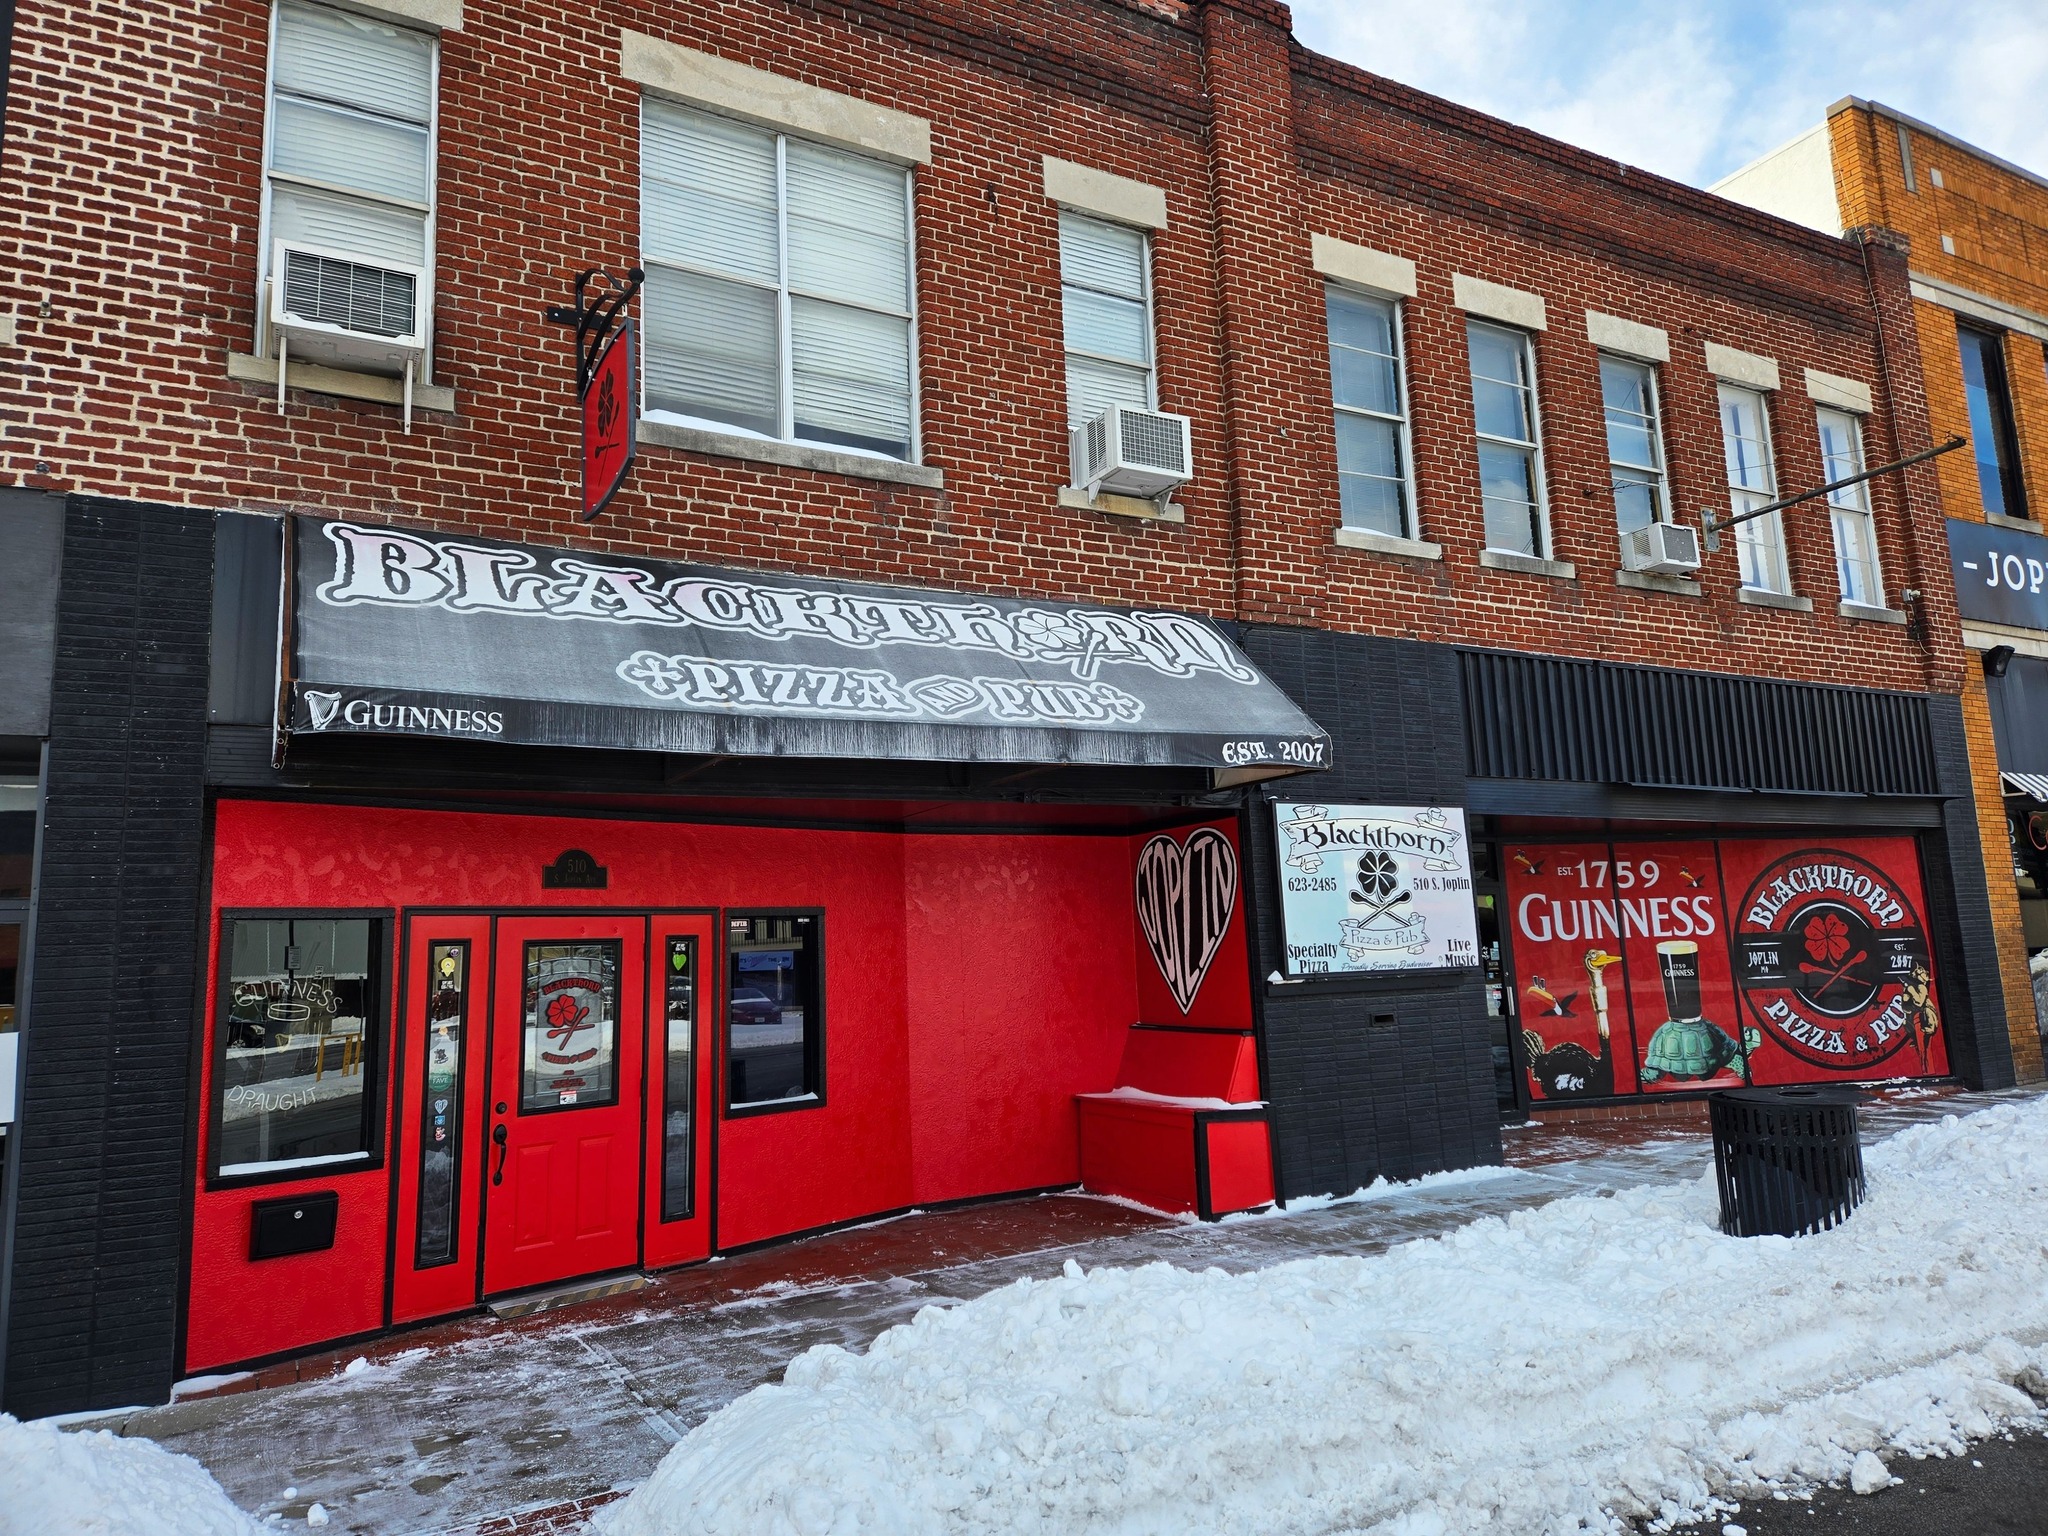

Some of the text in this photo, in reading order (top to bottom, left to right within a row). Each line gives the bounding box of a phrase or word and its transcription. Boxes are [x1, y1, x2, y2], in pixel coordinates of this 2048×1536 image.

[1986, 551, 2048, 594] JOP
[680, 657, 1098, 721] PIZZA AND PUB
[344, 699, 504, 734] GUINNESS
[1222, 741, 1324, 764] EST. 2007
[1298, 820, 1446, 855] Blackthorn
[567, 859, 587, 873] 510
[1557, 858, 1660, 889] EST. 1759
[1288, 877, 1337, 892] 623-2485
[1413, 876, 1471, 892] 510 S. Joplin
[1747, 864, 1904, 930] BLACKTHORN
[1140, 836, 1233, 1005] JOPLIN
[1518, 893, 1715, 942] GUINNESS
[1351, 929, 1418, 945] Pizza & Pub
[1447, 938, 1472, 952] Live
[1288, 942, 1338, 960] Specialty
[1445, 953, 1477, 968] Music
[1748, 951, 1779, 967] JOPLIN
[1890, 955, 1912, 968] 2007
[1300, 959, 1330, 973] Pizza
[1763, 998, 1848, 1054] PIZZA
[1856, 1036, 1868, 1051] &
[227, 1085, 316, 1112] DRAUGHT
